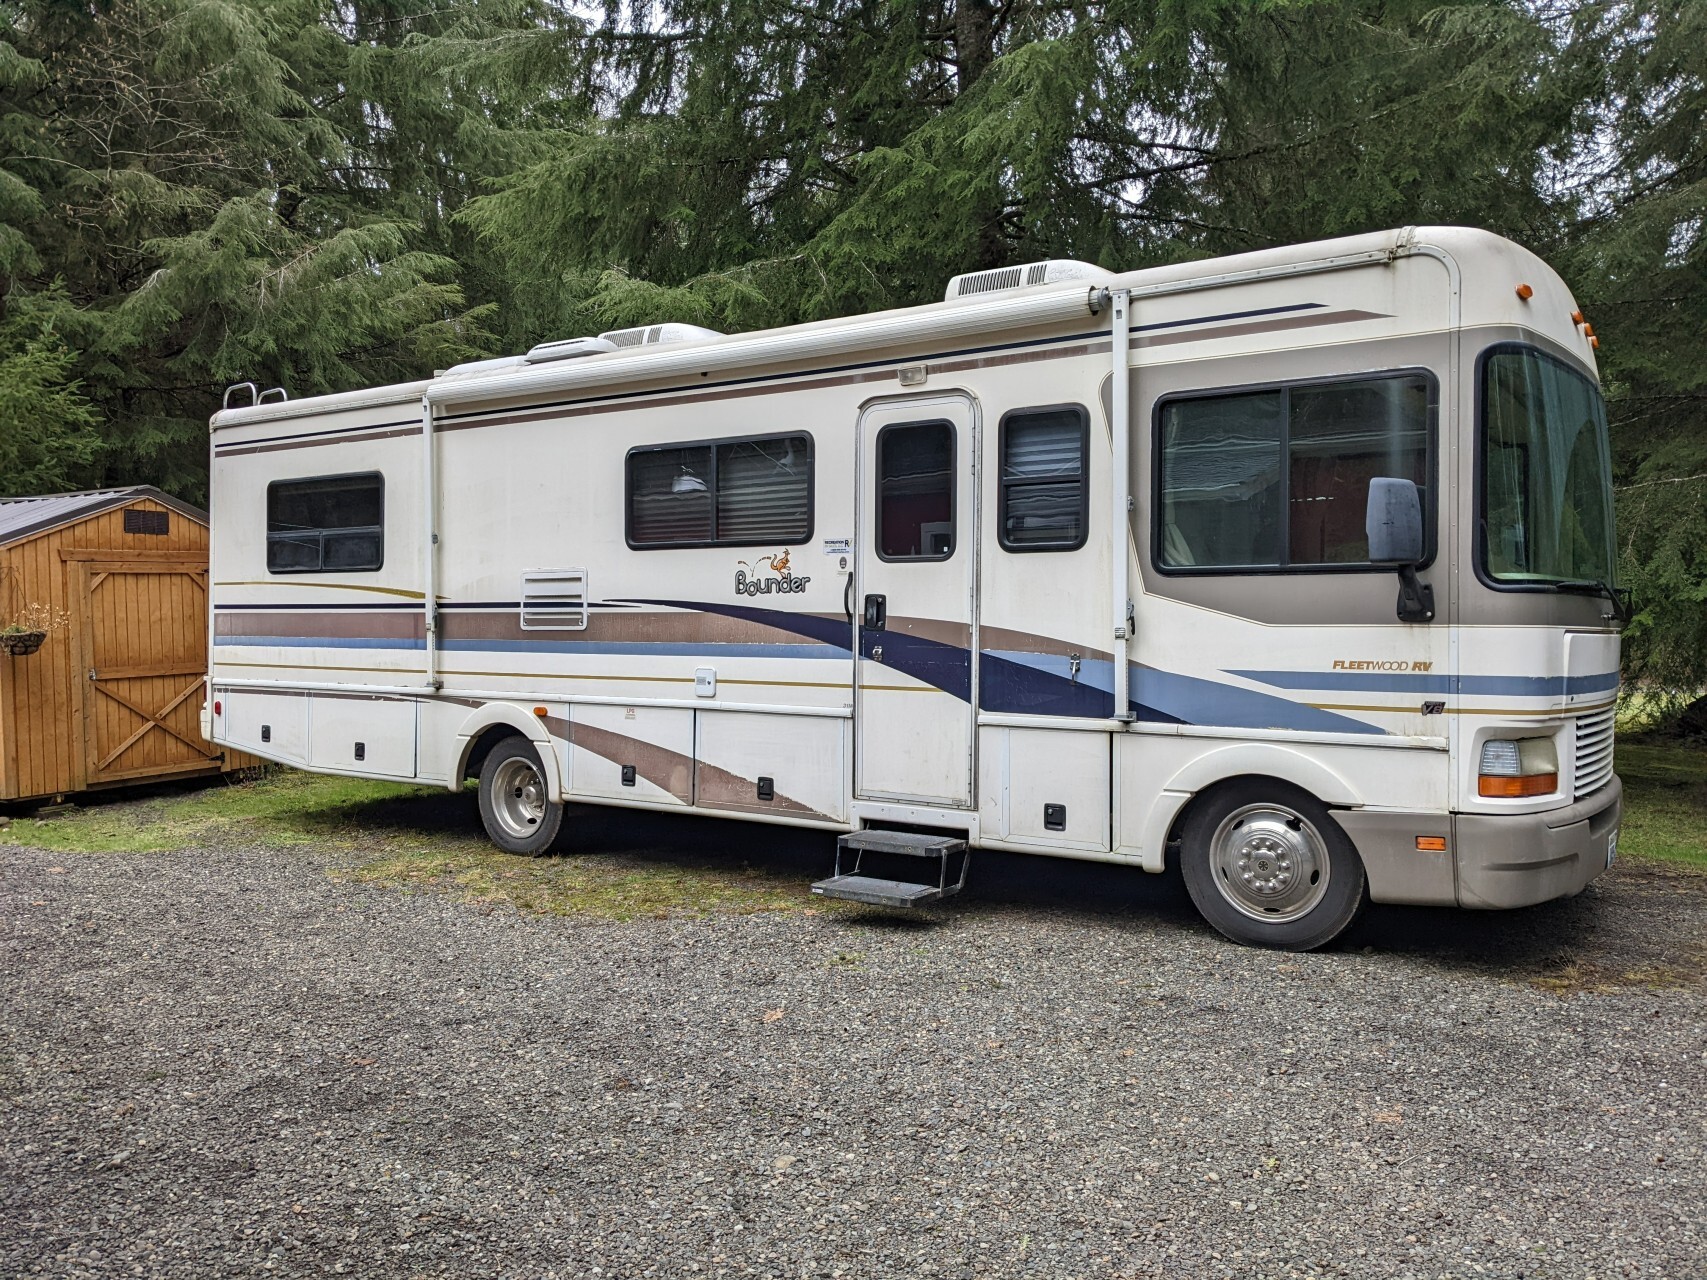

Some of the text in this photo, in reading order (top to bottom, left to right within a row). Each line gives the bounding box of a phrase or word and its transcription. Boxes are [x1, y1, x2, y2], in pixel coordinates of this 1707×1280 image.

[735, 570, 811, 596] Bounder
[1333, 660, 1433, 672] FLEETWOOD RV
